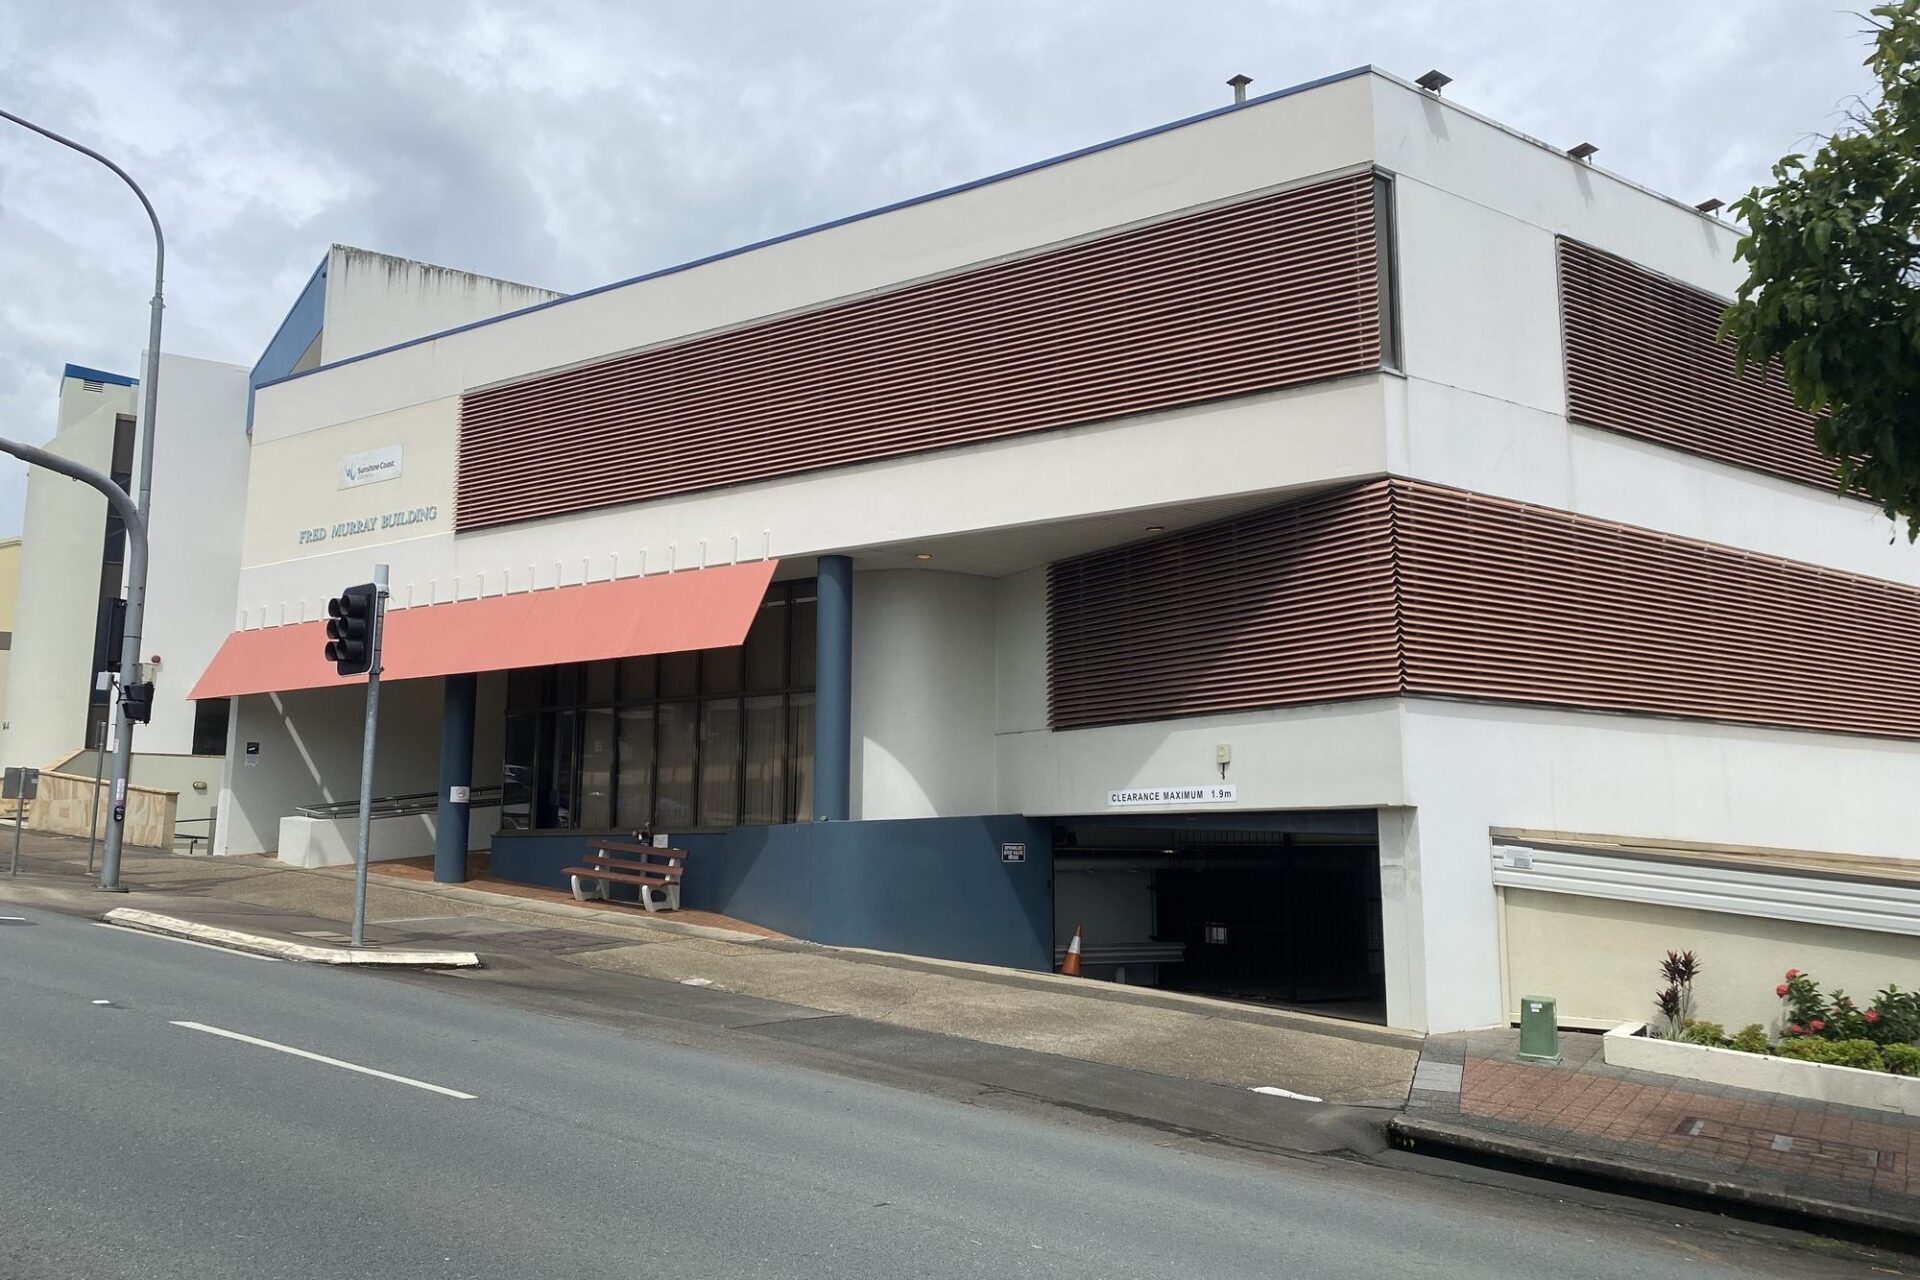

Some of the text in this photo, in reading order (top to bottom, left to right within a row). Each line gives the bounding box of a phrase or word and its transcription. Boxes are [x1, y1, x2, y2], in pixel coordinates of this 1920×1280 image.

[358, 460, 395, 474] Sunshine Coast
[299, 505, 437, 544] FRED MURRAY BUILDING
[1111, 789, 1232, 802] CLEARANCE MAXIMUM 1.9m
